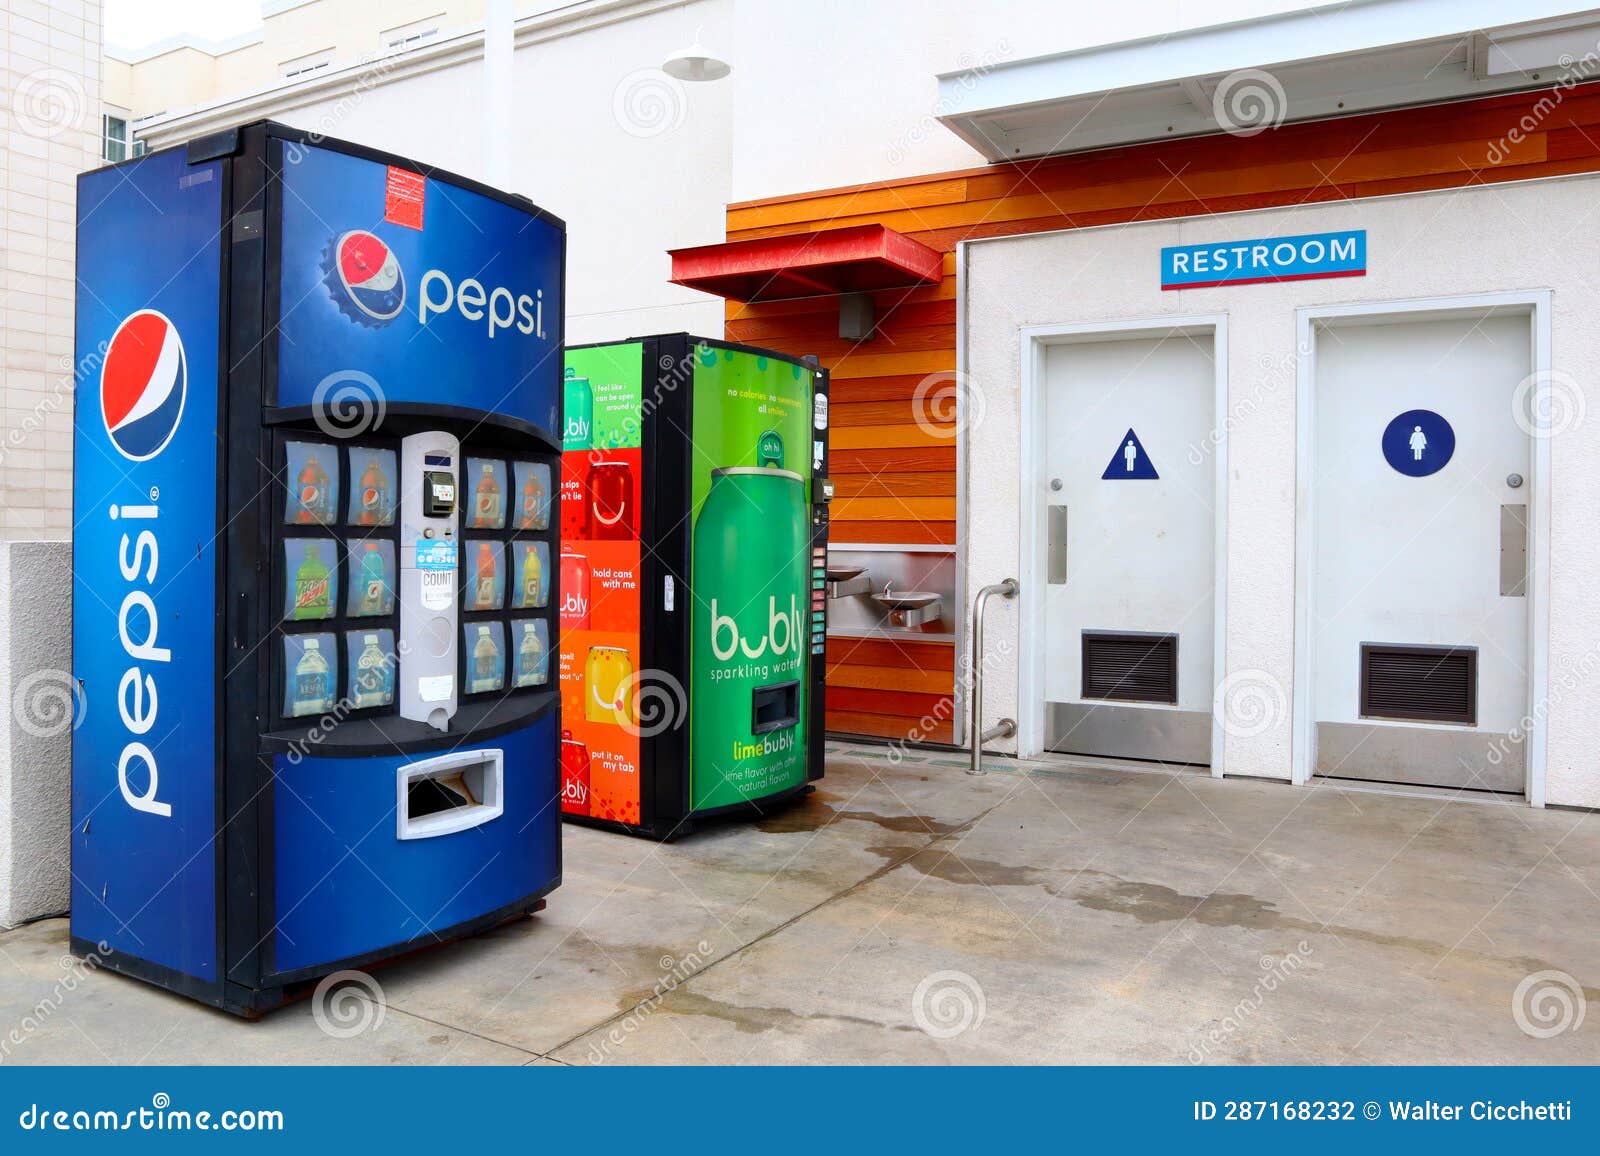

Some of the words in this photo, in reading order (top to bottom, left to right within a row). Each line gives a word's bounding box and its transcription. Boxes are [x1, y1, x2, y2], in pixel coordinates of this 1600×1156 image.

[1173, 238, 1356, 274] RESTROOM
[419, 269, 543, 339] pepsi
[728, 388, 737, 396] no
[758, 404, 767, 413] all
[764, 441, 773, 452] oh
[566, 480, 580, 490] sips
[573, 491, 582, 500] lie
[593, 568, 611, 577] hold
[613, 571, 633, 579] cans
[423, 573, 452, 586] COUNT
[602, 579, 620, 588] with
[622, 581, 636, 589] me
[711, 593, 805, 668] bubly
[710, 664, 768, 684] sparkling
[591, 751, 604, 760] put
[606, 752, 612, 760] it
[603, 761, 616, 772] my
[618, 762, 635, 773] tab
[745, 766, 767, 778] flavor
[738, 776, 767, 792] natural
